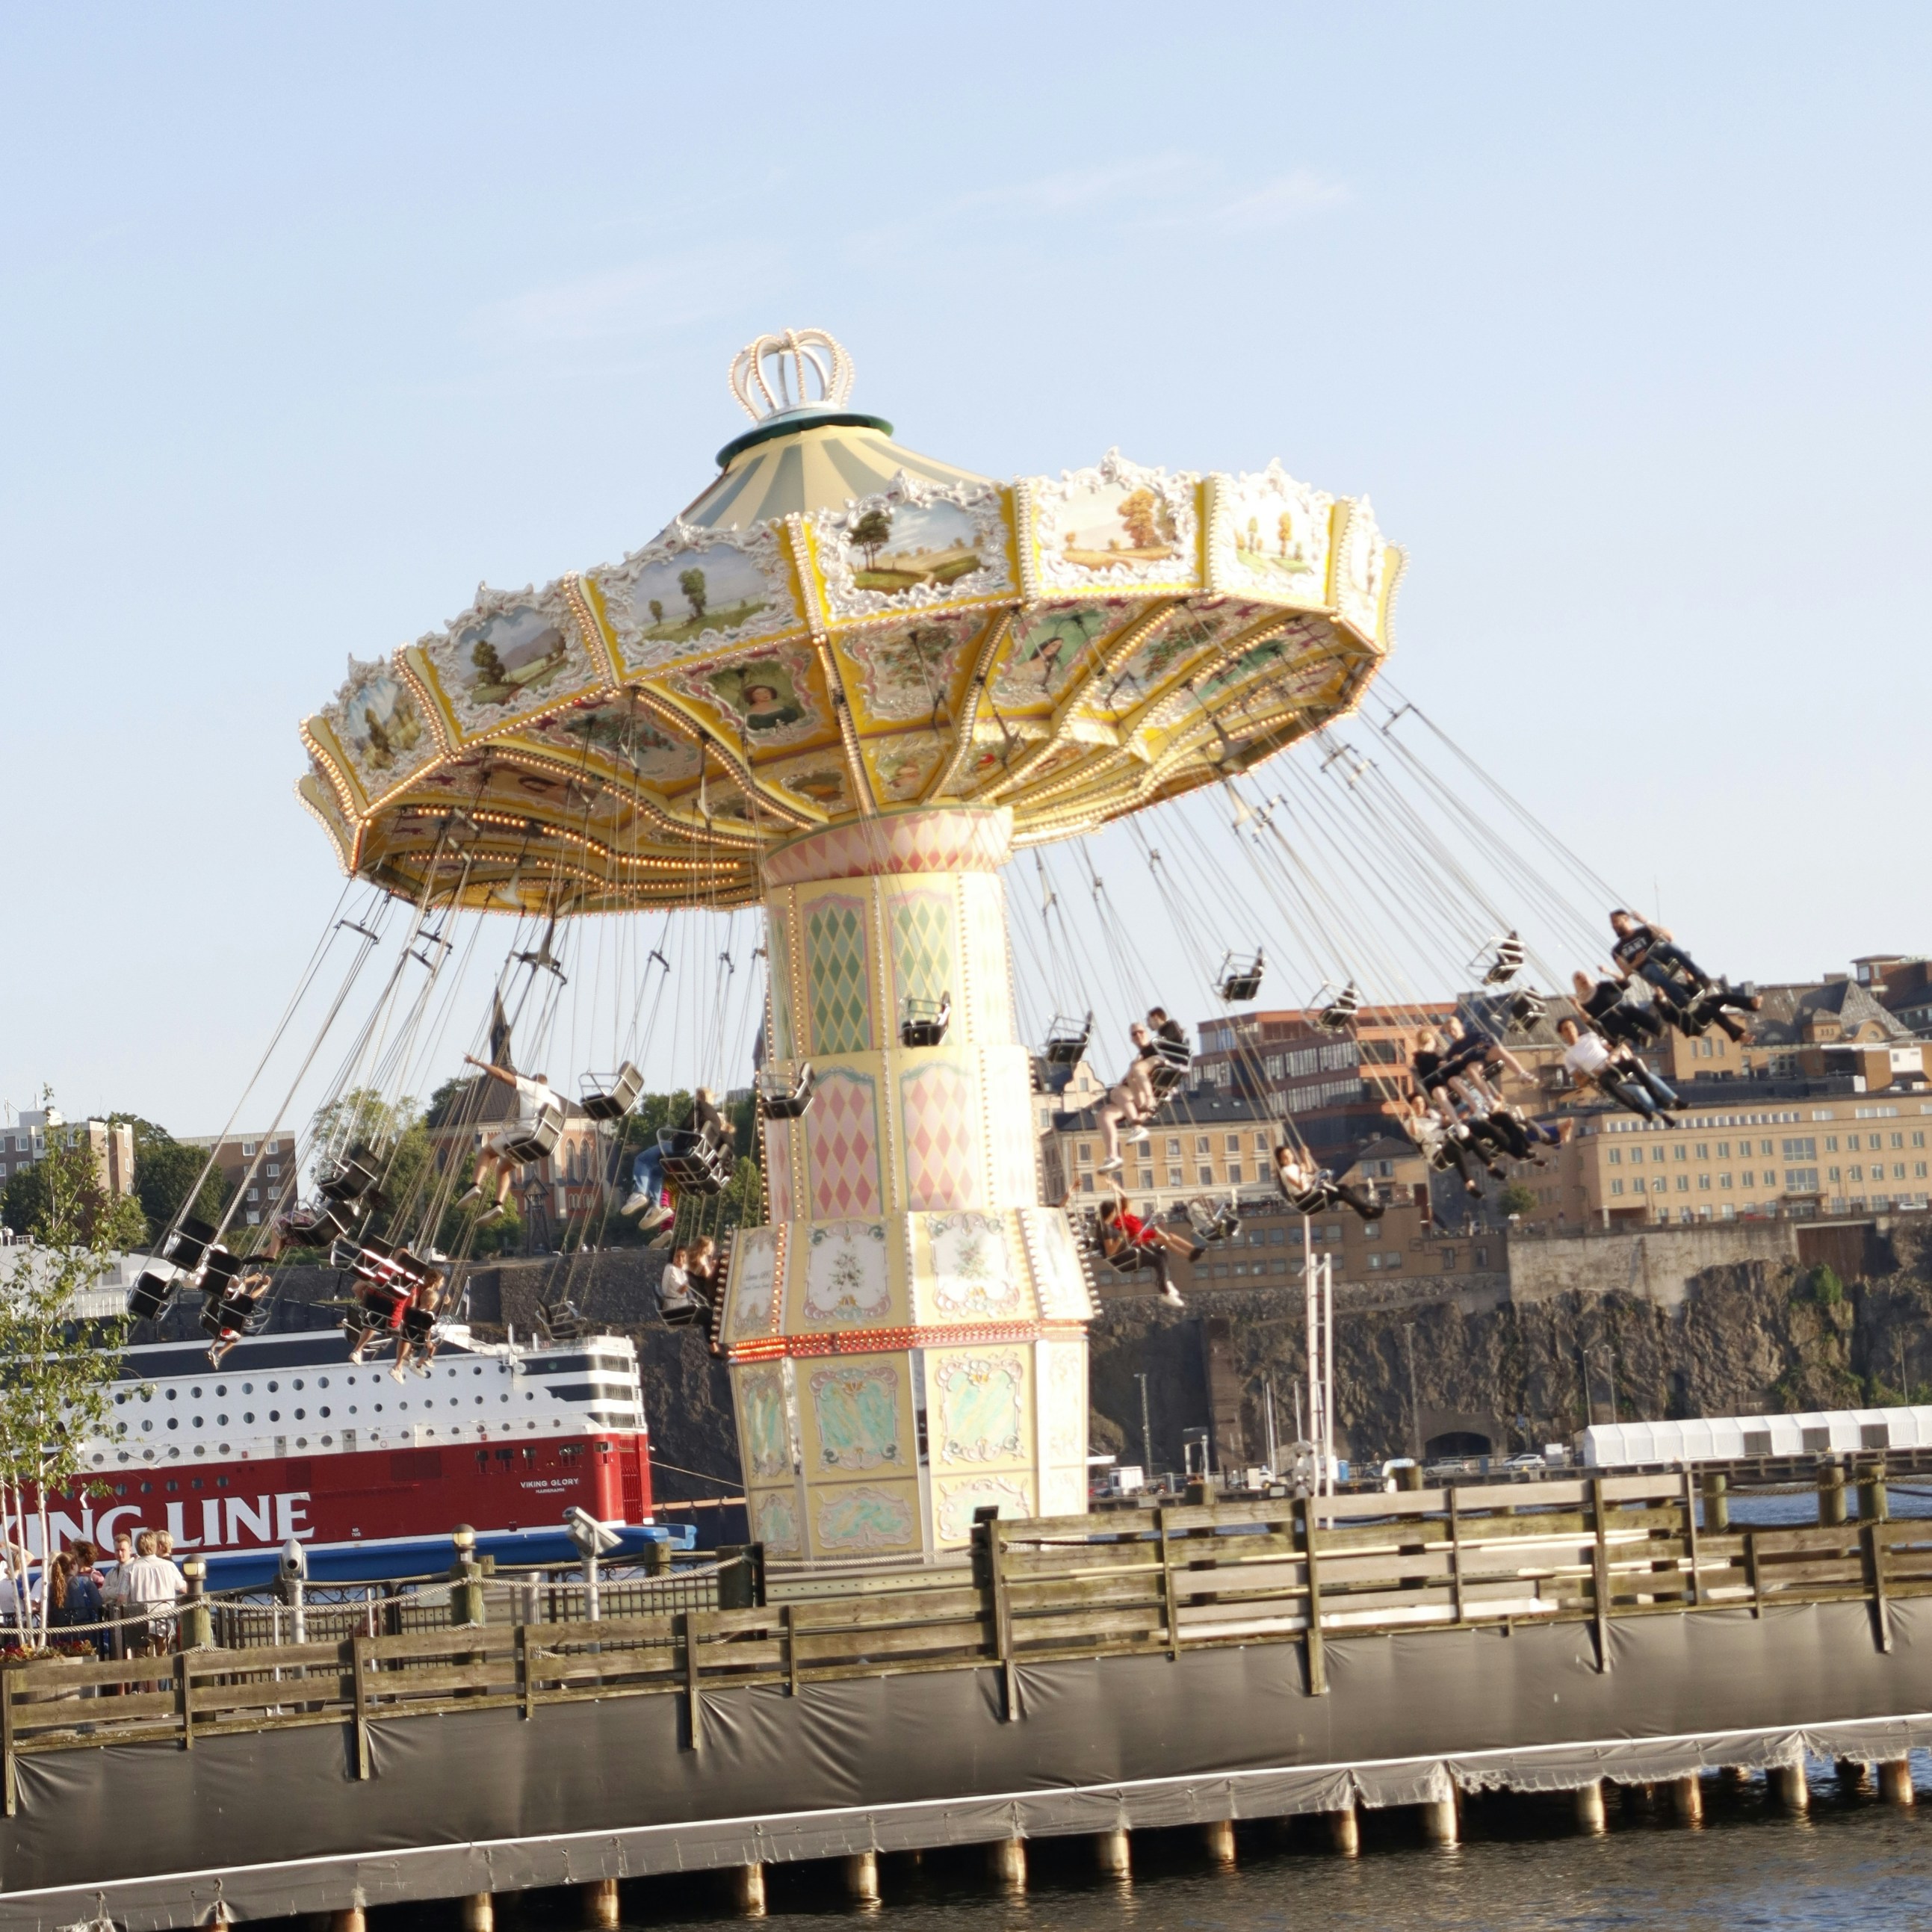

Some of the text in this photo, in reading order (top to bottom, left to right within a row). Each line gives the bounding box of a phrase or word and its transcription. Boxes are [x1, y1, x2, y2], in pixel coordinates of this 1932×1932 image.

[520, 1478, 579, 1488] VIKING GLORY
[165, 1491, 315, 1549] LINE
